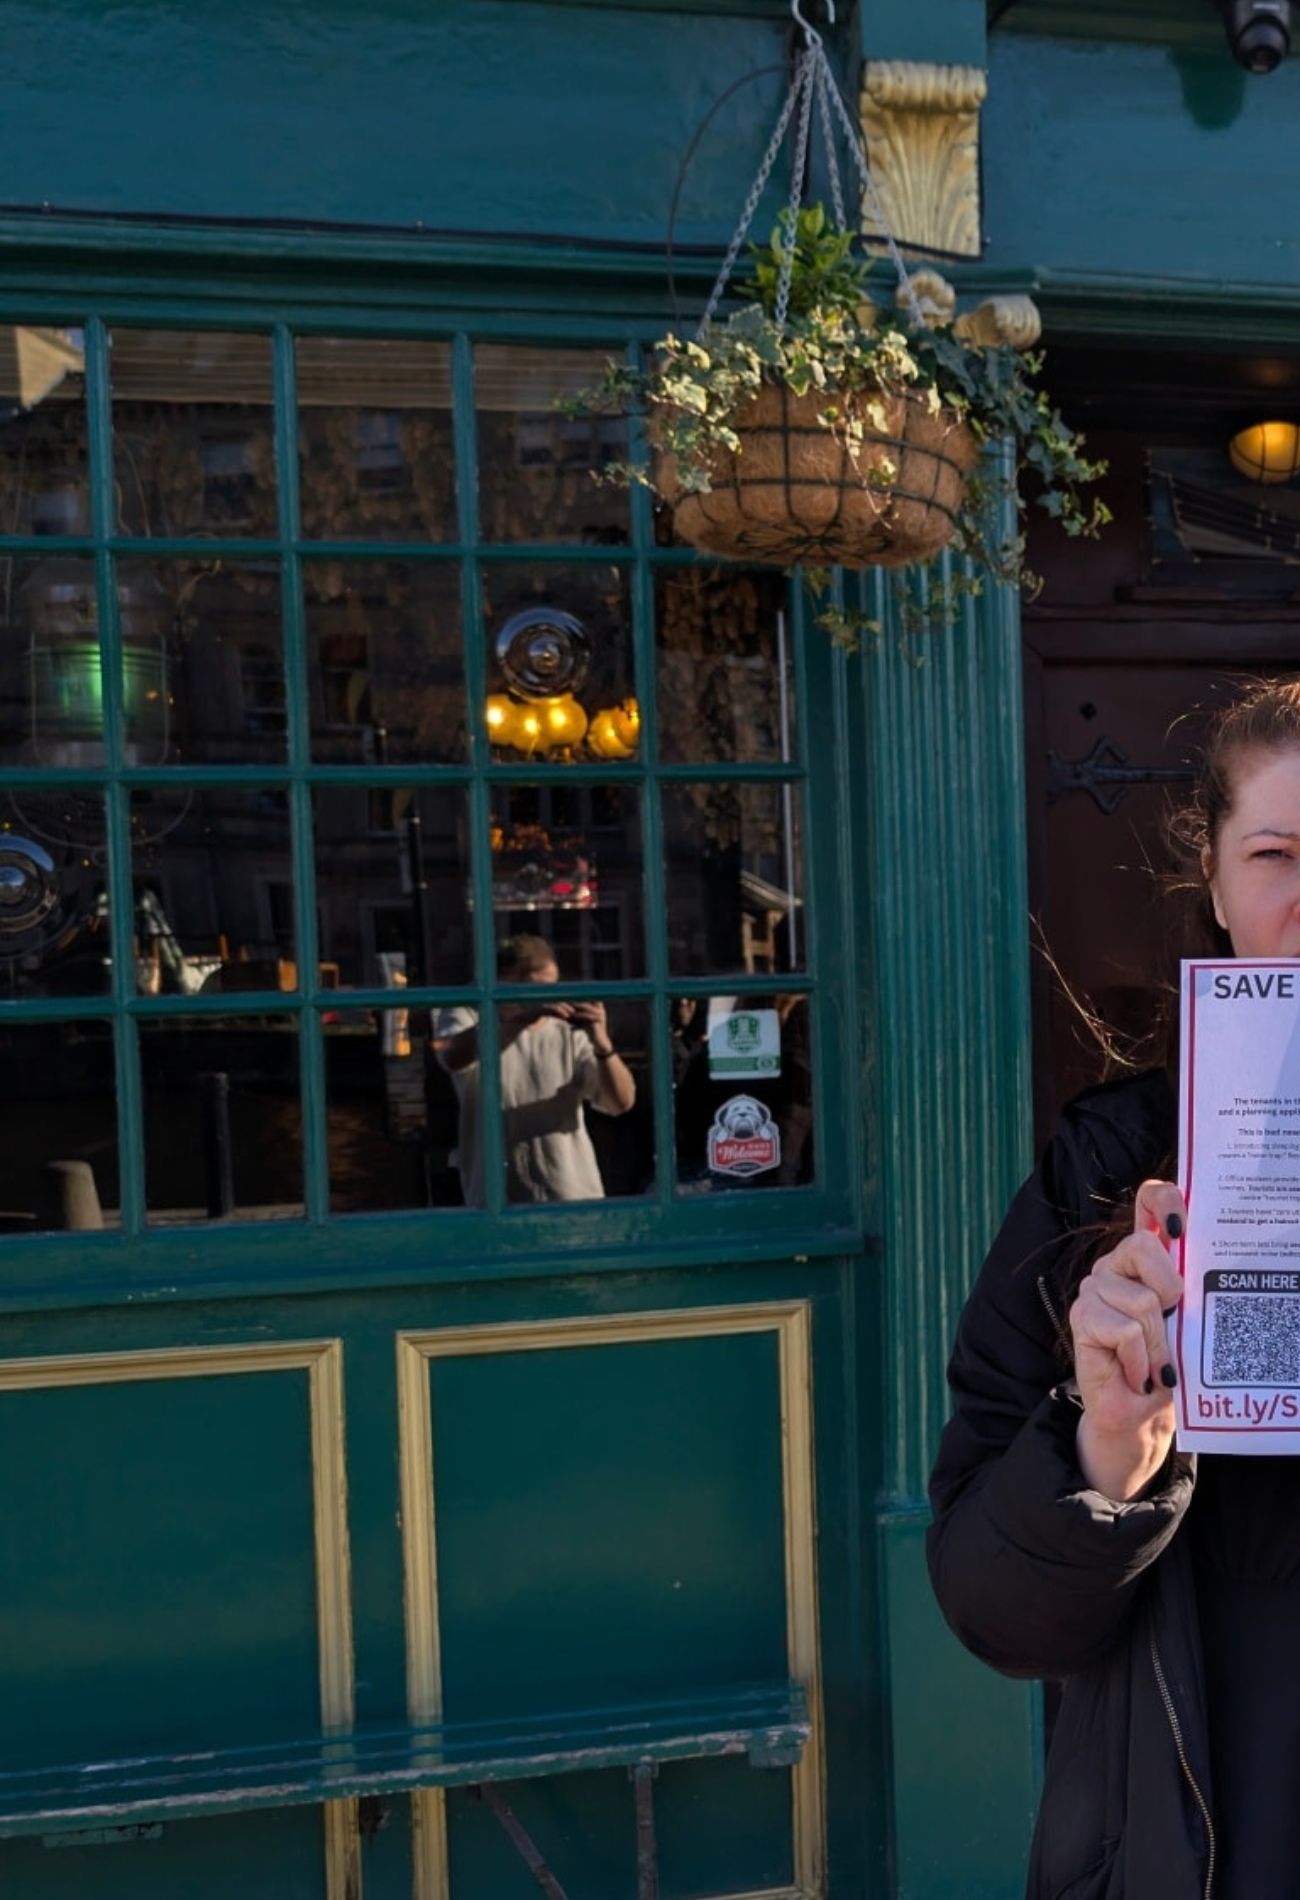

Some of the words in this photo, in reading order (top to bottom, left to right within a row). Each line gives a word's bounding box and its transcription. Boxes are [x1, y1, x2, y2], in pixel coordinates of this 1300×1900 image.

[1214, 974, 1294, 999] SAVE
[1242, 1109, 1277, 1117] planning
[1218, 1274, 1257, 1288] SCAN
[1261, 1275, 1299, 1289] HERE
